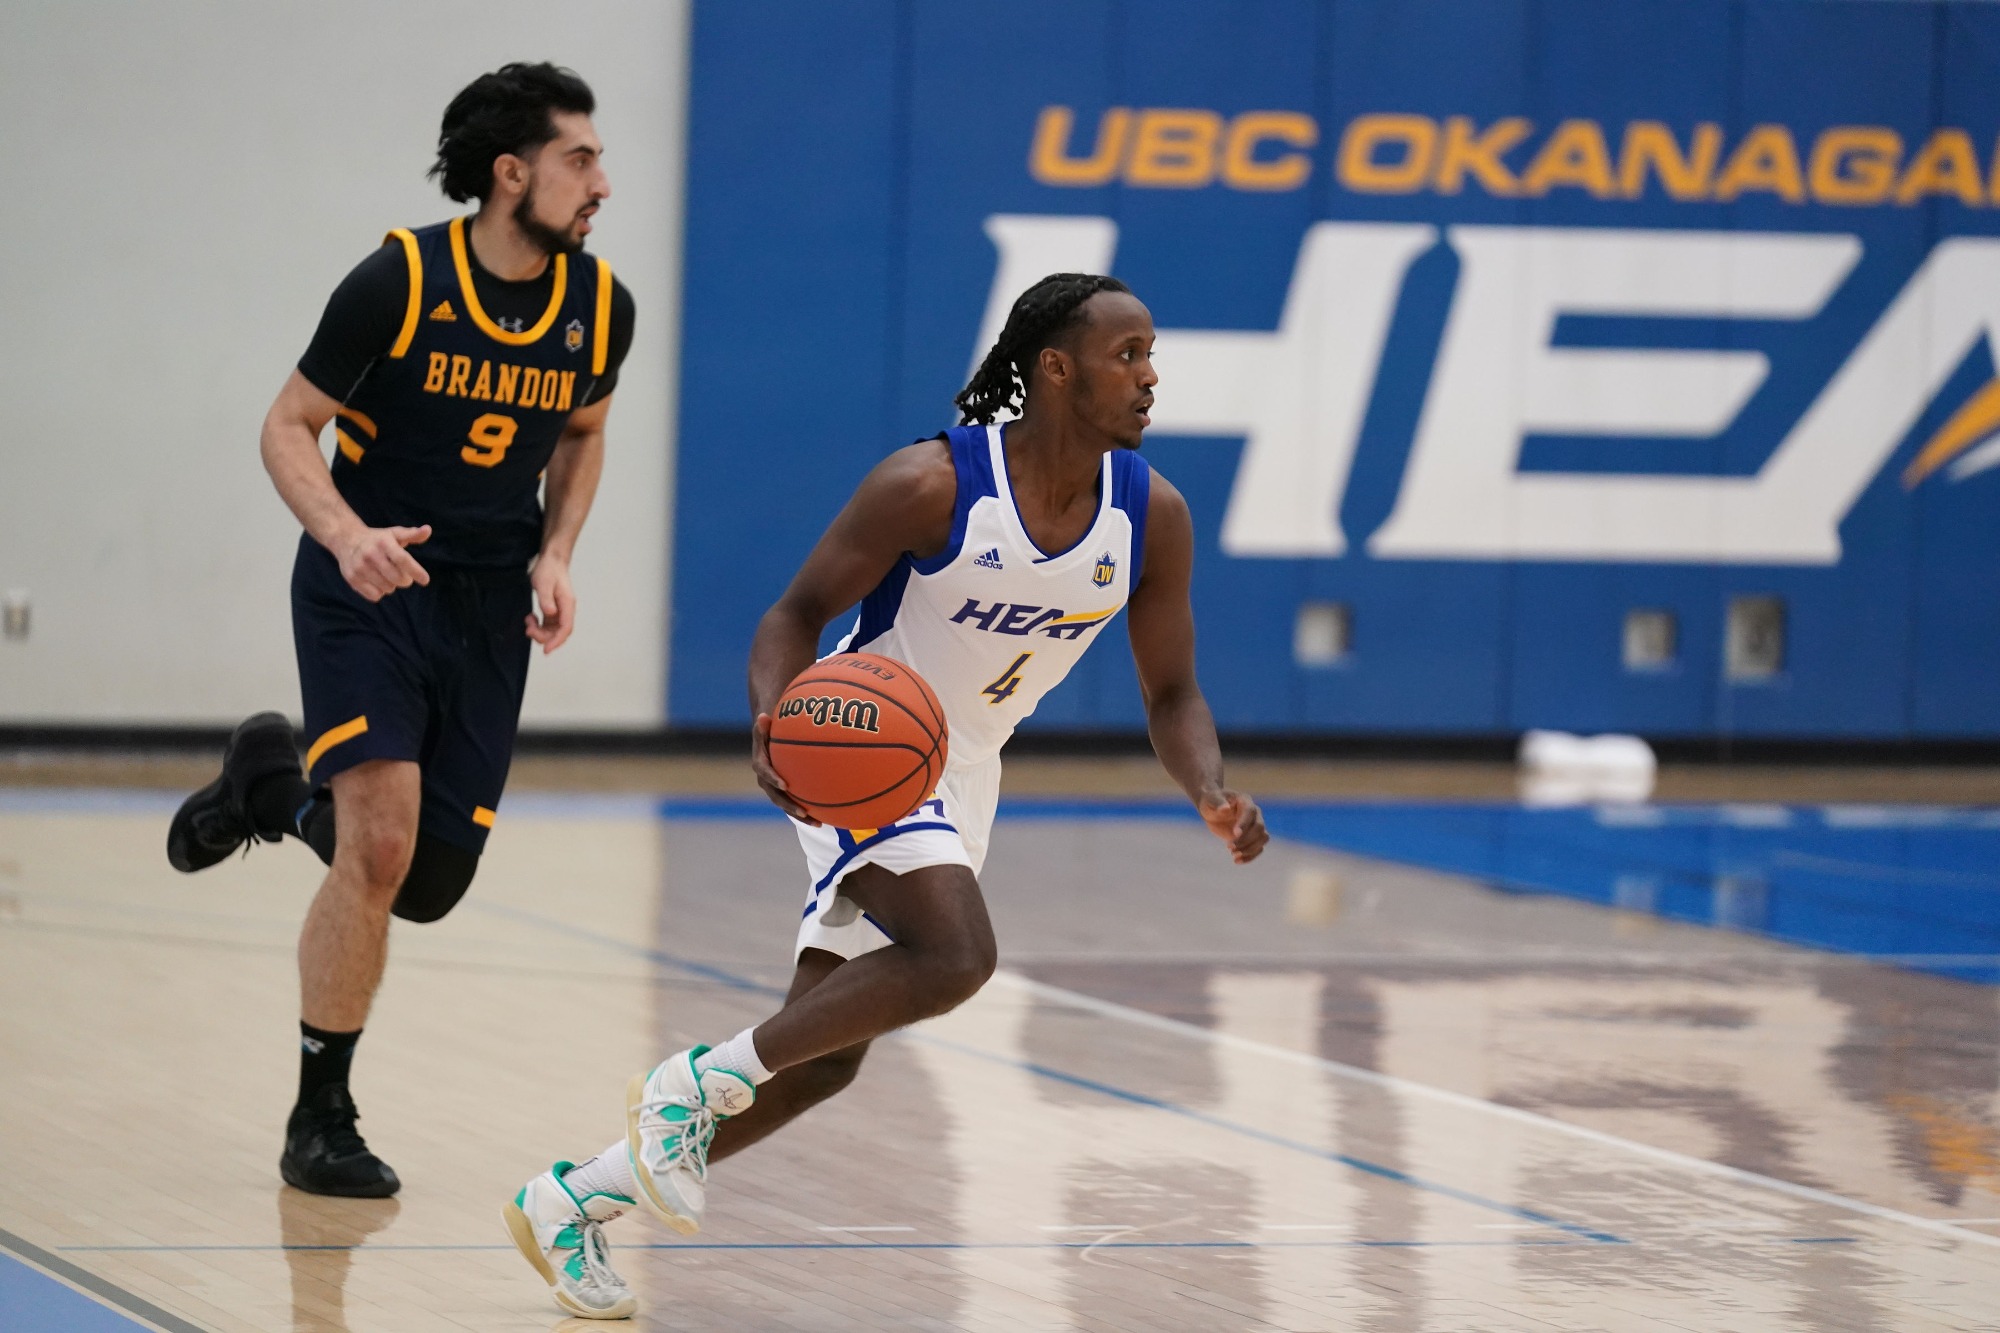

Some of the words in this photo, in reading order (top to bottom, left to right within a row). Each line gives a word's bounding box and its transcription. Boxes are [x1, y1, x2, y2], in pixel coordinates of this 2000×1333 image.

[1030, 105, 1318, 191] UBC
[1335, 113, 2000, 207] OKANAGA
[423, 351, 576, 412] BRANDON
[460, 412, 519, 468] 9
[973, 558, 1004, 570] adidas
[949, 598, 1122, 640] HEAT
[979, 650, 1035, 707] 4
[777, 696, 880, 734] Wilson
